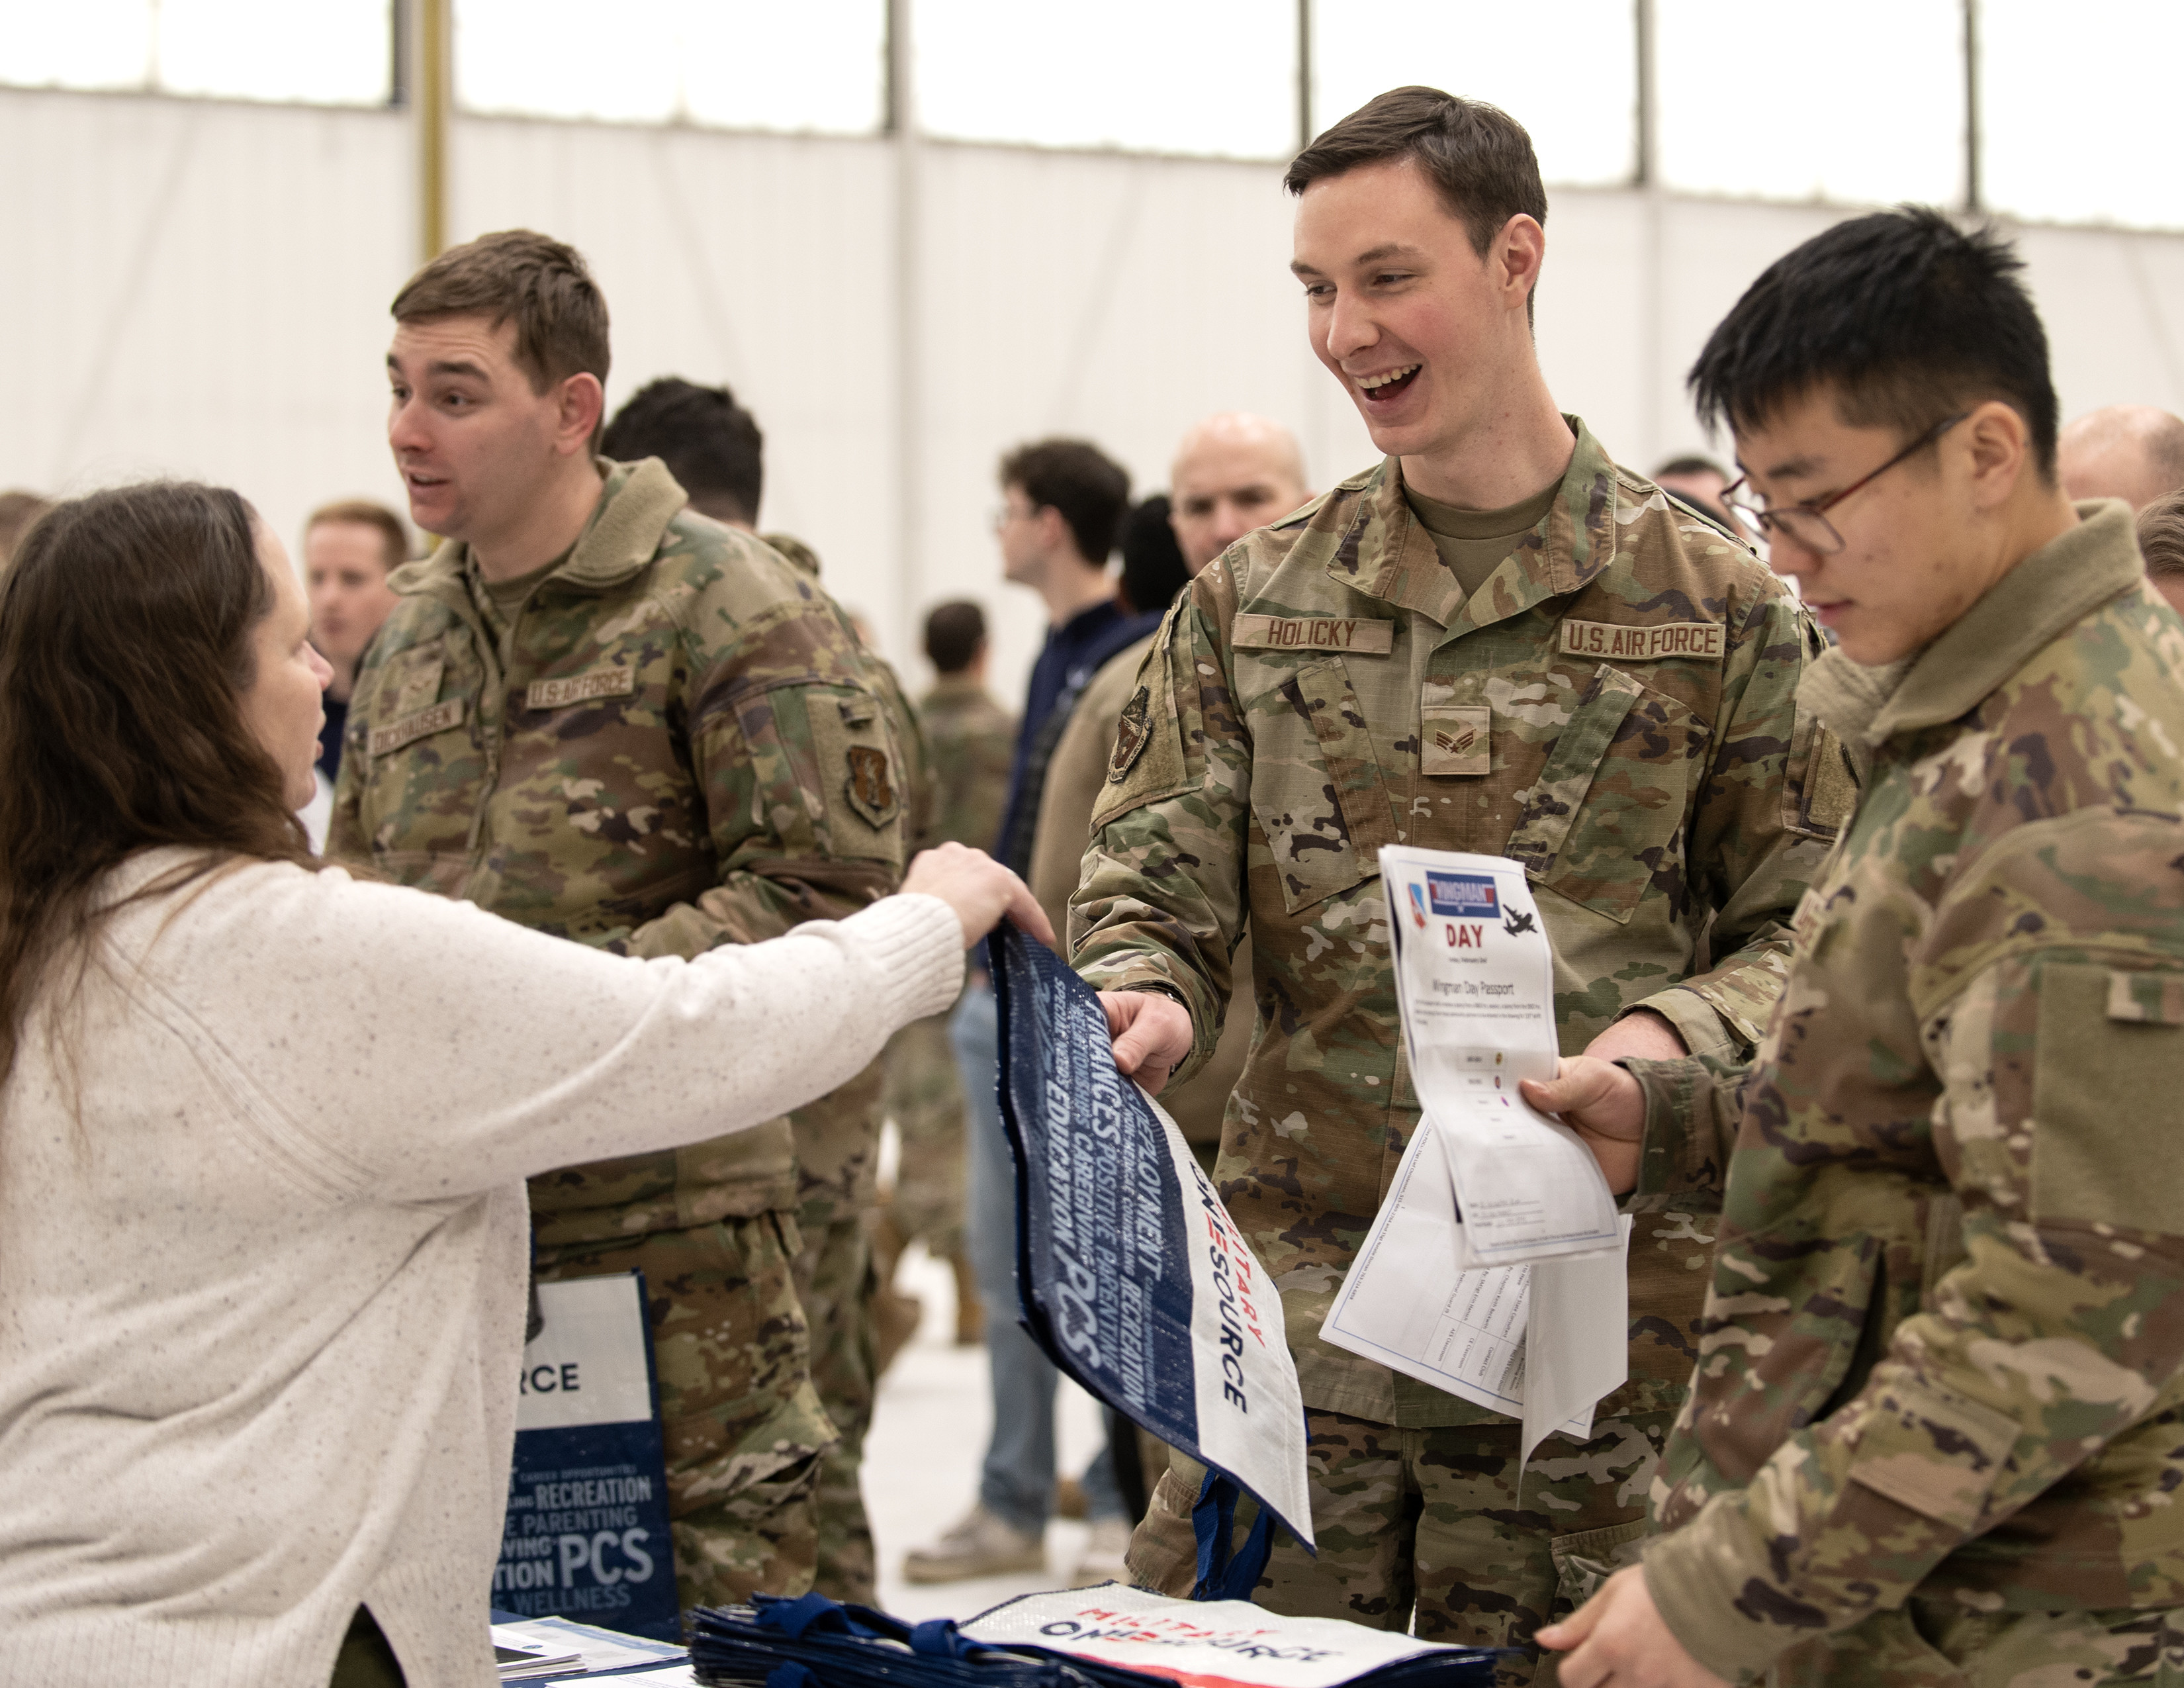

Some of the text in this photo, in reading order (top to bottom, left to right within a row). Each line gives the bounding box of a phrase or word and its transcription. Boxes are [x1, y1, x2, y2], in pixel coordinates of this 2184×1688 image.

[1267, 620, 1357, 647] HOLICKY
[1611, 630, 1646, 655] AIR
[1650, 627, 1719, 654] FORCE
[1437, 880, 1487, 903] WINGMAN
[1446, 923, 1483, 948] DAY
[1432, 979, 1514, 998] Wingman Day Passport
[1046, 1078, 1076, 1251] EDUCATION
[1053, 1002, 1101, 1369] RELATIONSHIPS CAREGIVING PCS
[1084, 1000, 1121, 1375] FINANCES POSITIVE PARENTING
[1130, 1100, 1161, 1282] DEPLOYMENT
[1453, 1273, 1465, 1293] National
[1497, 1274, 1509, 1294] Chaplain
[1447, 1293, 1456, 1307] Guard
[1502, 1312, 1516, 1337] Consultant
[1120, 1274, 1146, 1414] RECREATION
[1437, 1337, 1451, 1362] Classroom
[1457, 1344, 1471, 1368] Classroom
[1482, 1346, 1494, 1365] Contact
[534, 1476, 653, 1511] RECREATION
[522, 1505, 638, 1534] PARENTING
[559, 1528, 654, 1588] PCS
[514, 1584, 631, 1615] WELLNESS
